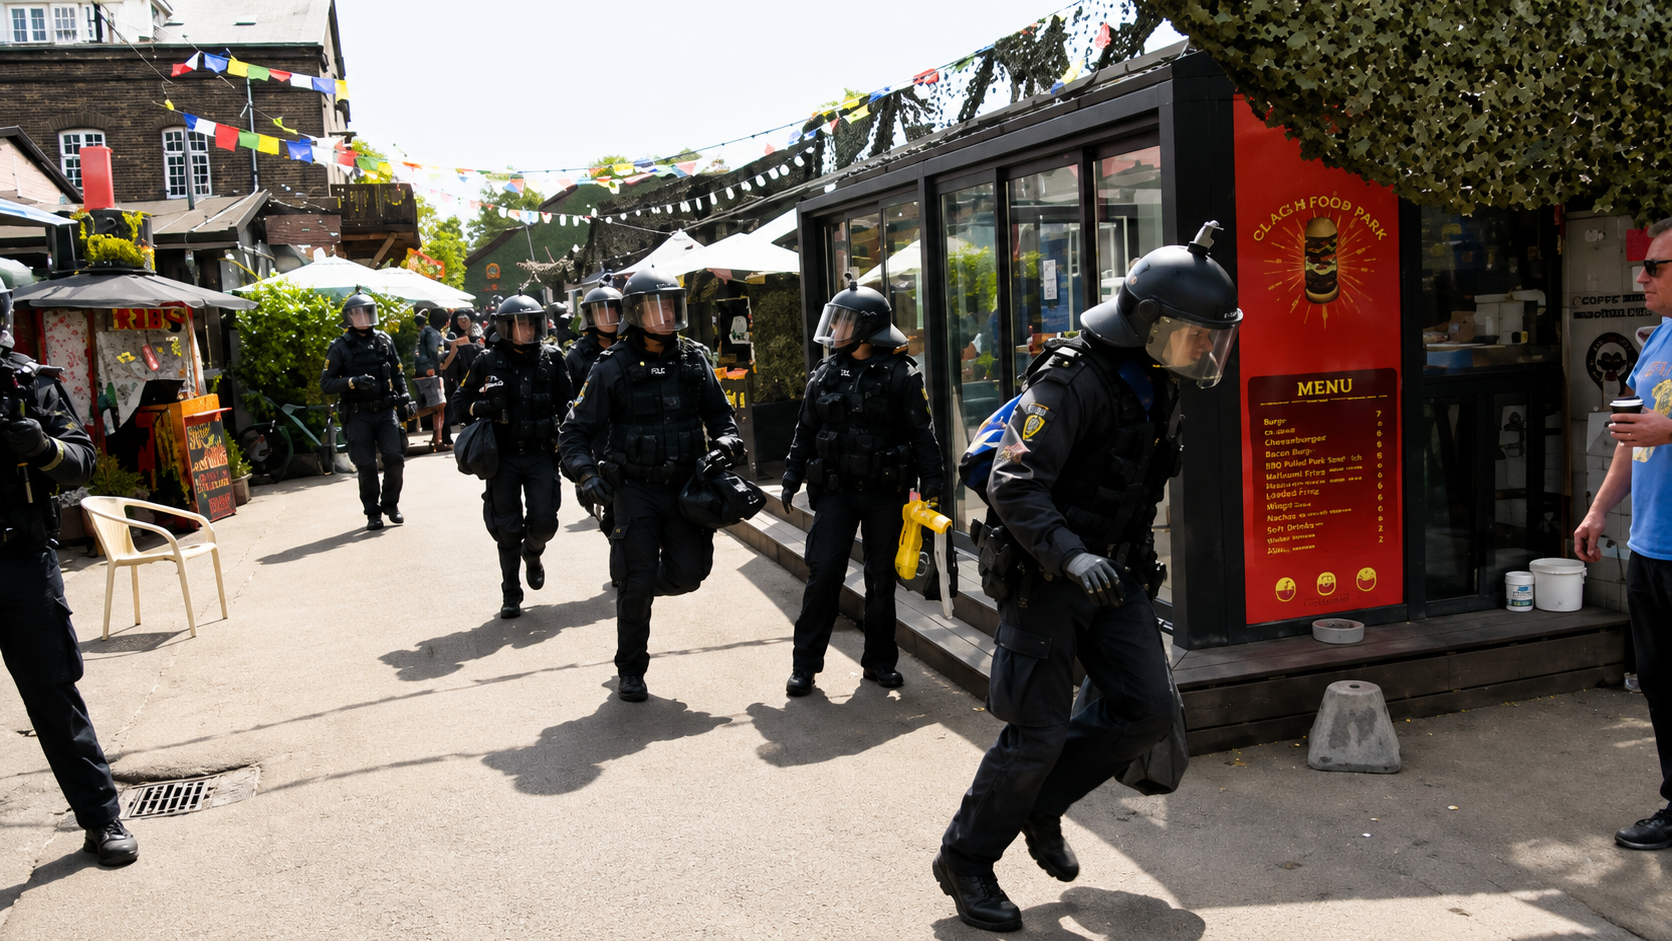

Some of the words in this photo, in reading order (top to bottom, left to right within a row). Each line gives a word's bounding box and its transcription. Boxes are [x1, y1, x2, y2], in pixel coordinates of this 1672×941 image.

[1354, 206, 1388, 241] PARK
[1297, 378, 1353, 396] MENU
[1378, 535, 1384, 543] 2
